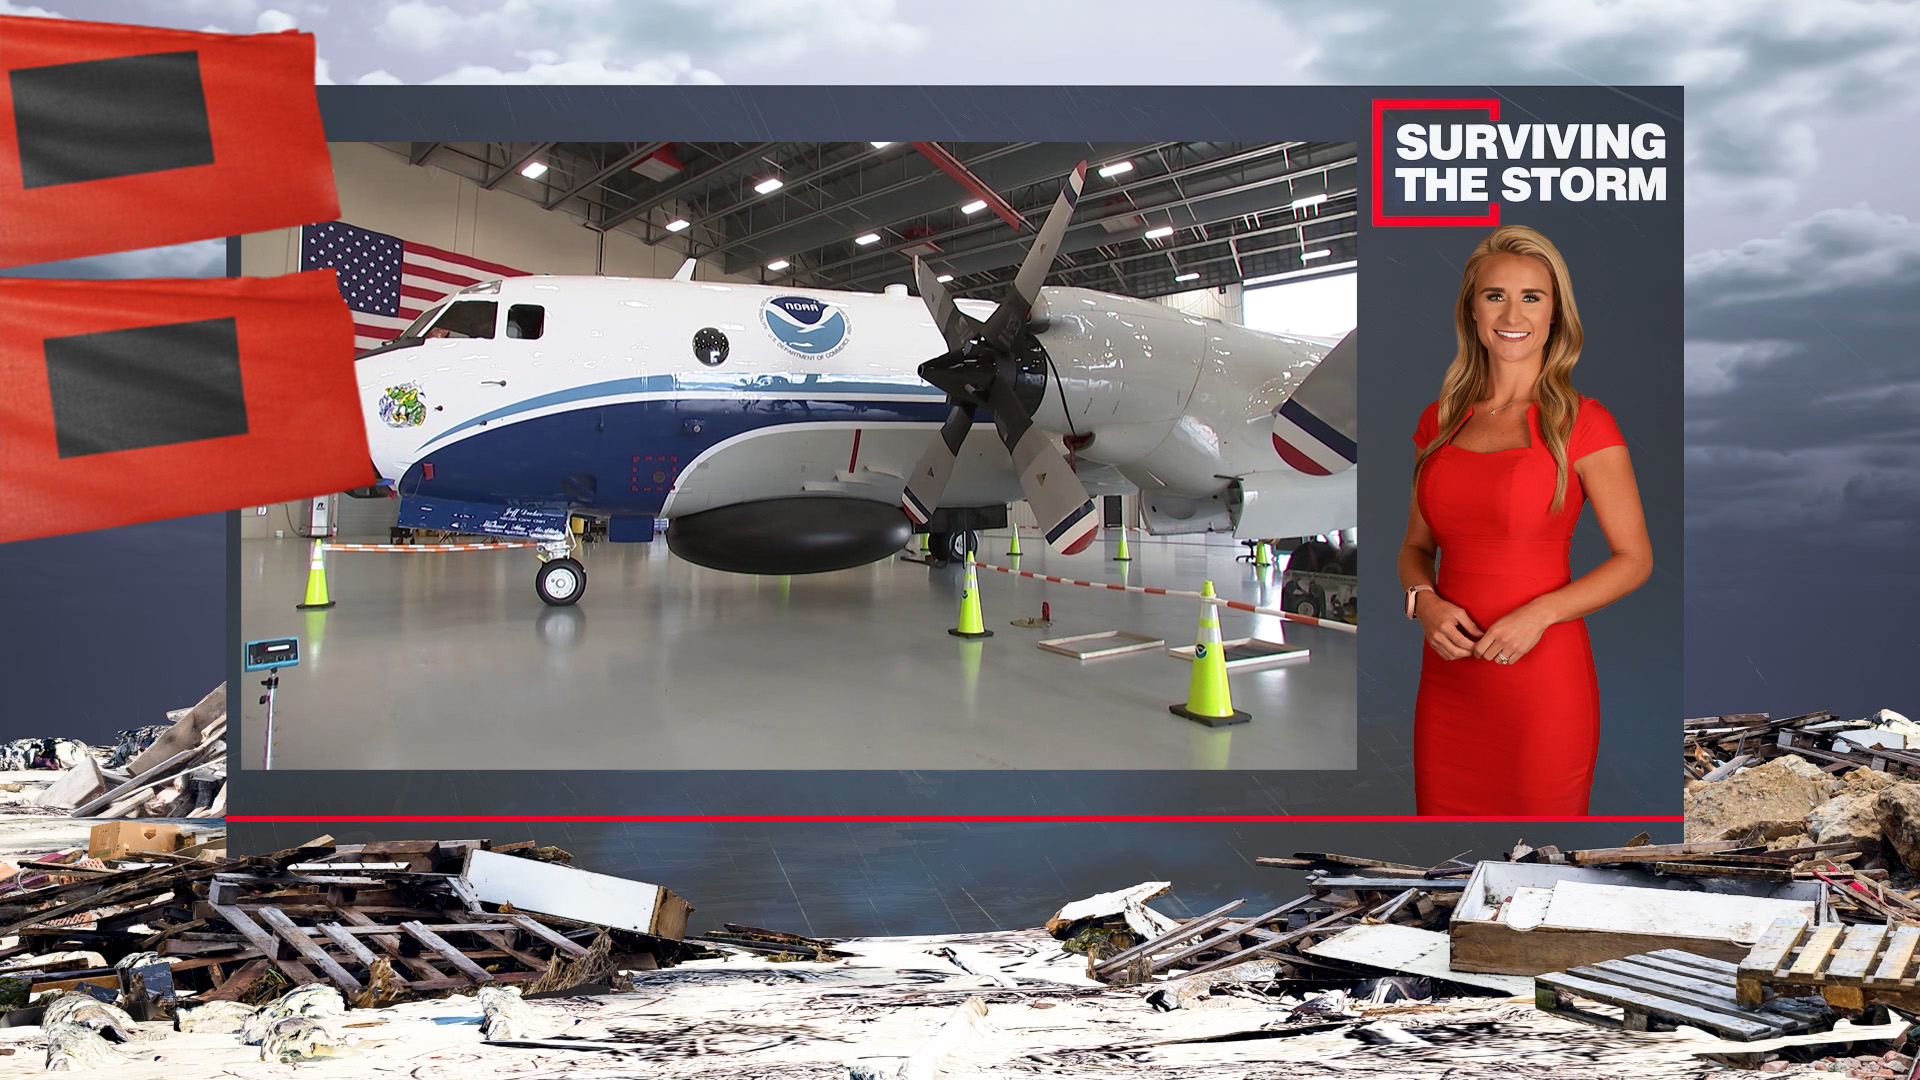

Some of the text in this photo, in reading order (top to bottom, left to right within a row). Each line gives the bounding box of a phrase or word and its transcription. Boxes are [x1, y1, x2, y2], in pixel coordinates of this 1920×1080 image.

[785, 302, 819, 311] NOAA
[777, 342, 815, 361] DEPARTMENT
[816, 353, 825, 361] OF
[825, 337, 851, 359] COMMERCE
